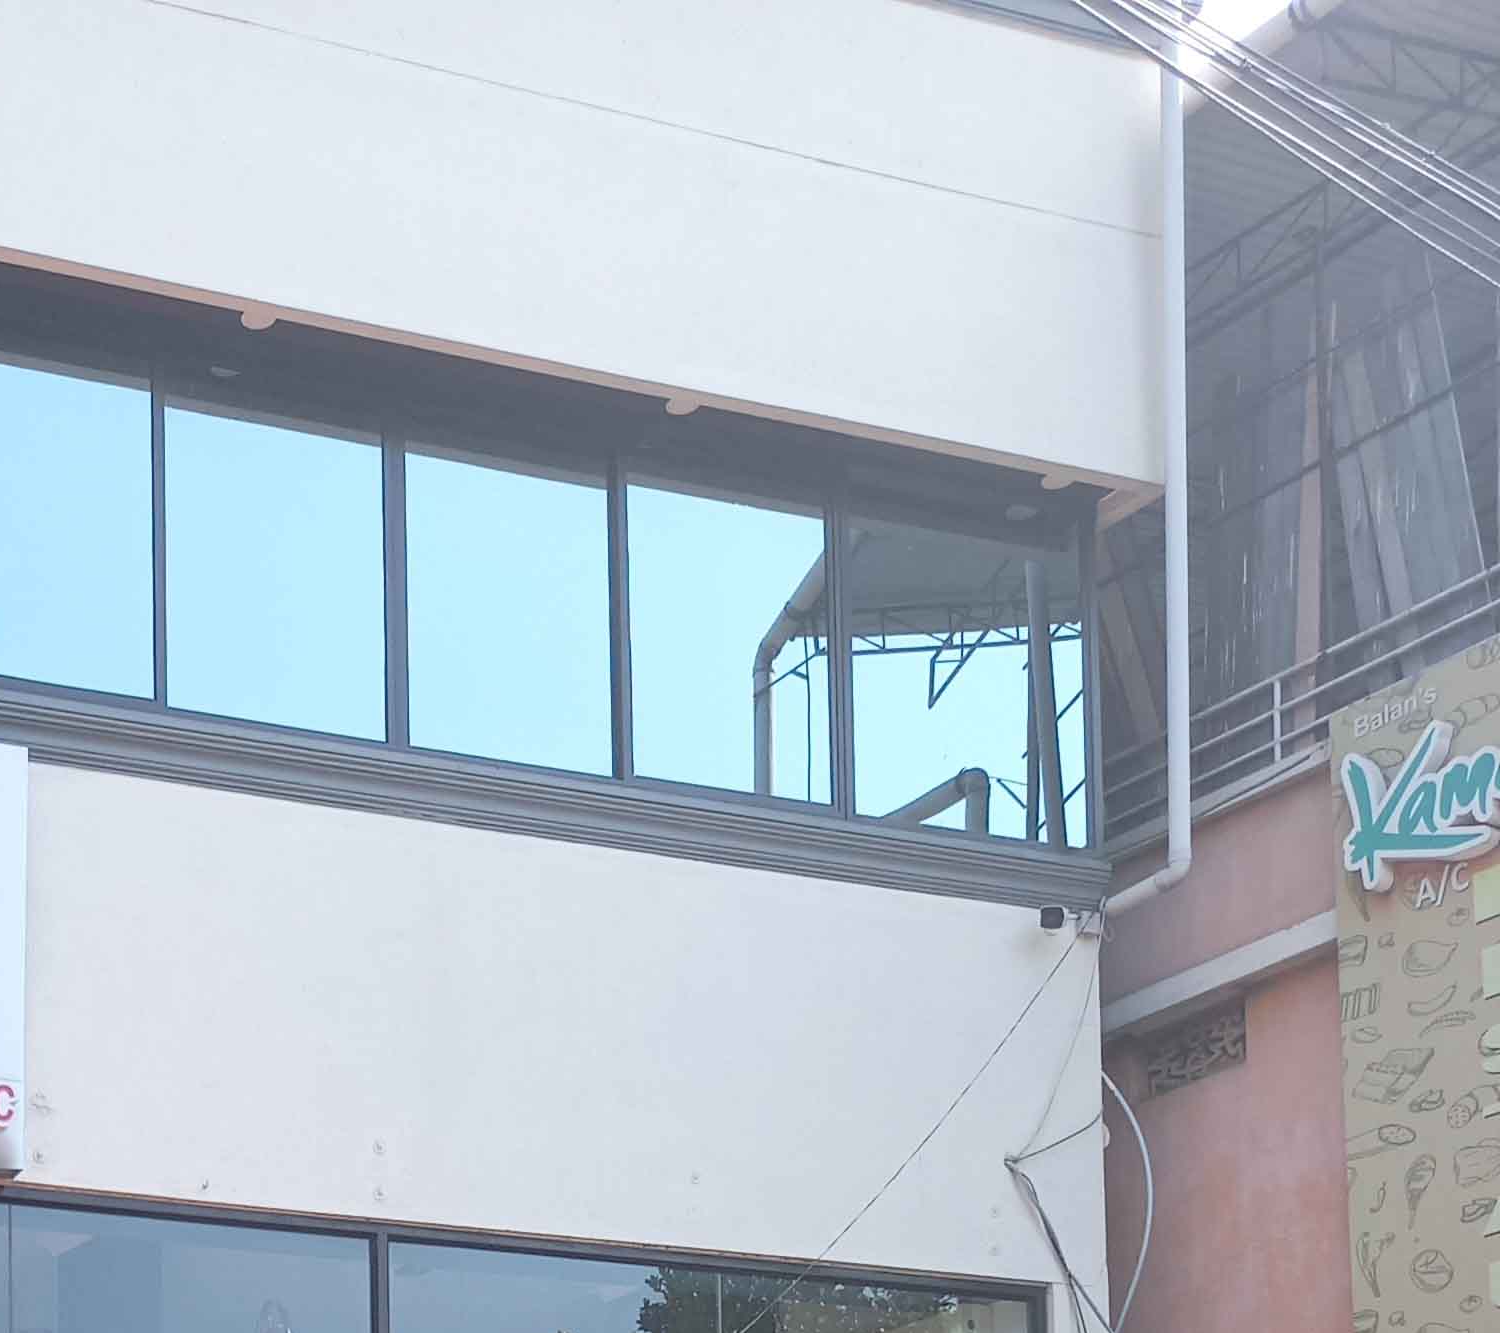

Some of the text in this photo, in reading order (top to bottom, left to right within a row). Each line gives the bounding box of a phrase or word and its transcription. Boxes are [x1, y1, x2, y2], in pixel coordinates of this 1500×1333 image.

[1353, 687, 1438, 738] Balan's
[1347, 724, 1500, 883] Kam
[1416, 862, 1470, 909] A/C
